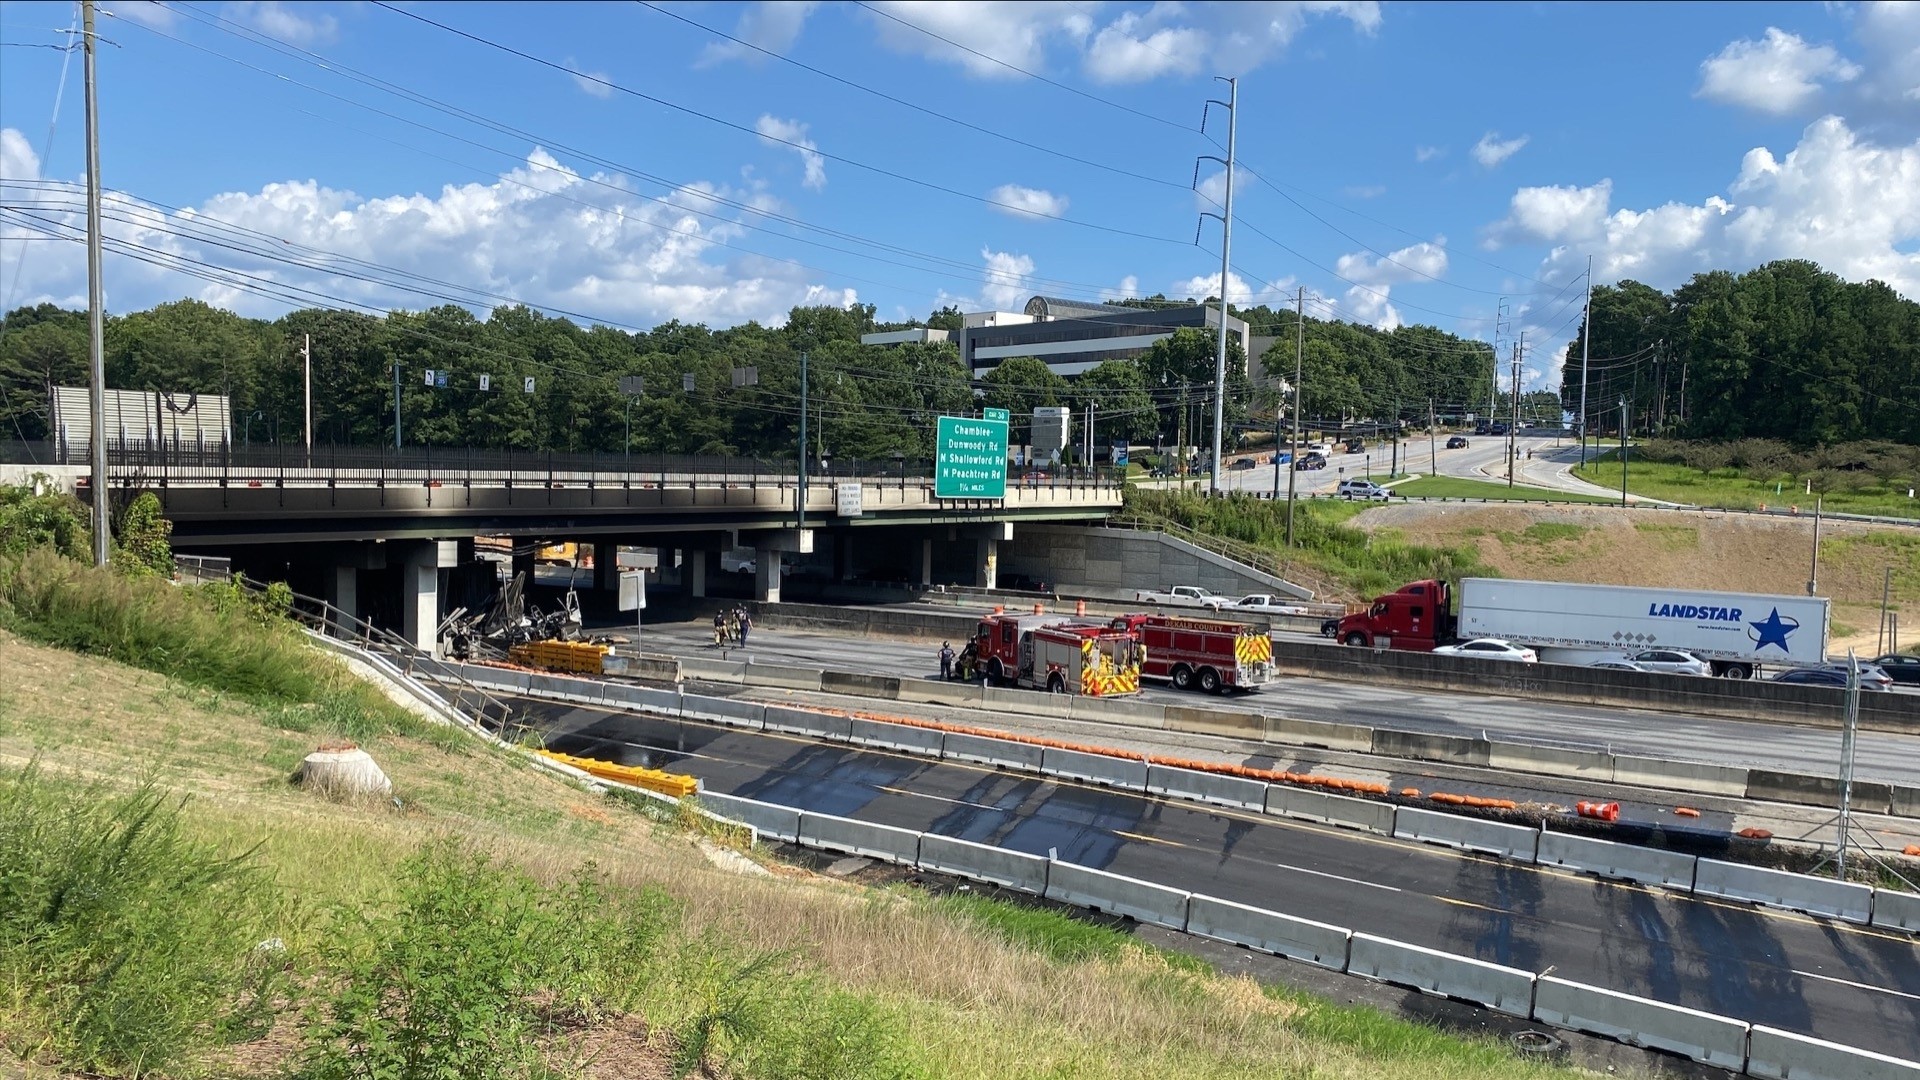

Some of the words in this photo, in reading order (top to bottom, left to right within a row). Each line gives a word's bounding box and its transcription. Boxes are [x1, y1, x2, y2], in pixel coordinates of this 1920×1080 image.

[998, 412, 1004, 420] 30
[954, 424, 993, 436] Chamblee-
[948, 439, 986, 453] Dunwoody
[989, 442, 998, 451] Rd
[941, 453, 946, 462] N
[949, 453, 992, 465] Shallowford
[995, 456, 1004, 466] Rd
[943, 468, 949, 477] N
[952, 469, 989, 479] Peachtree
[991, 470, 1000, 479] Rd
[1649, 603, 1742, 621] LANDSTAR
[1165, 620, 1193, 629] DEKALB
[1194, 623, 1223, 632] COUNTY
